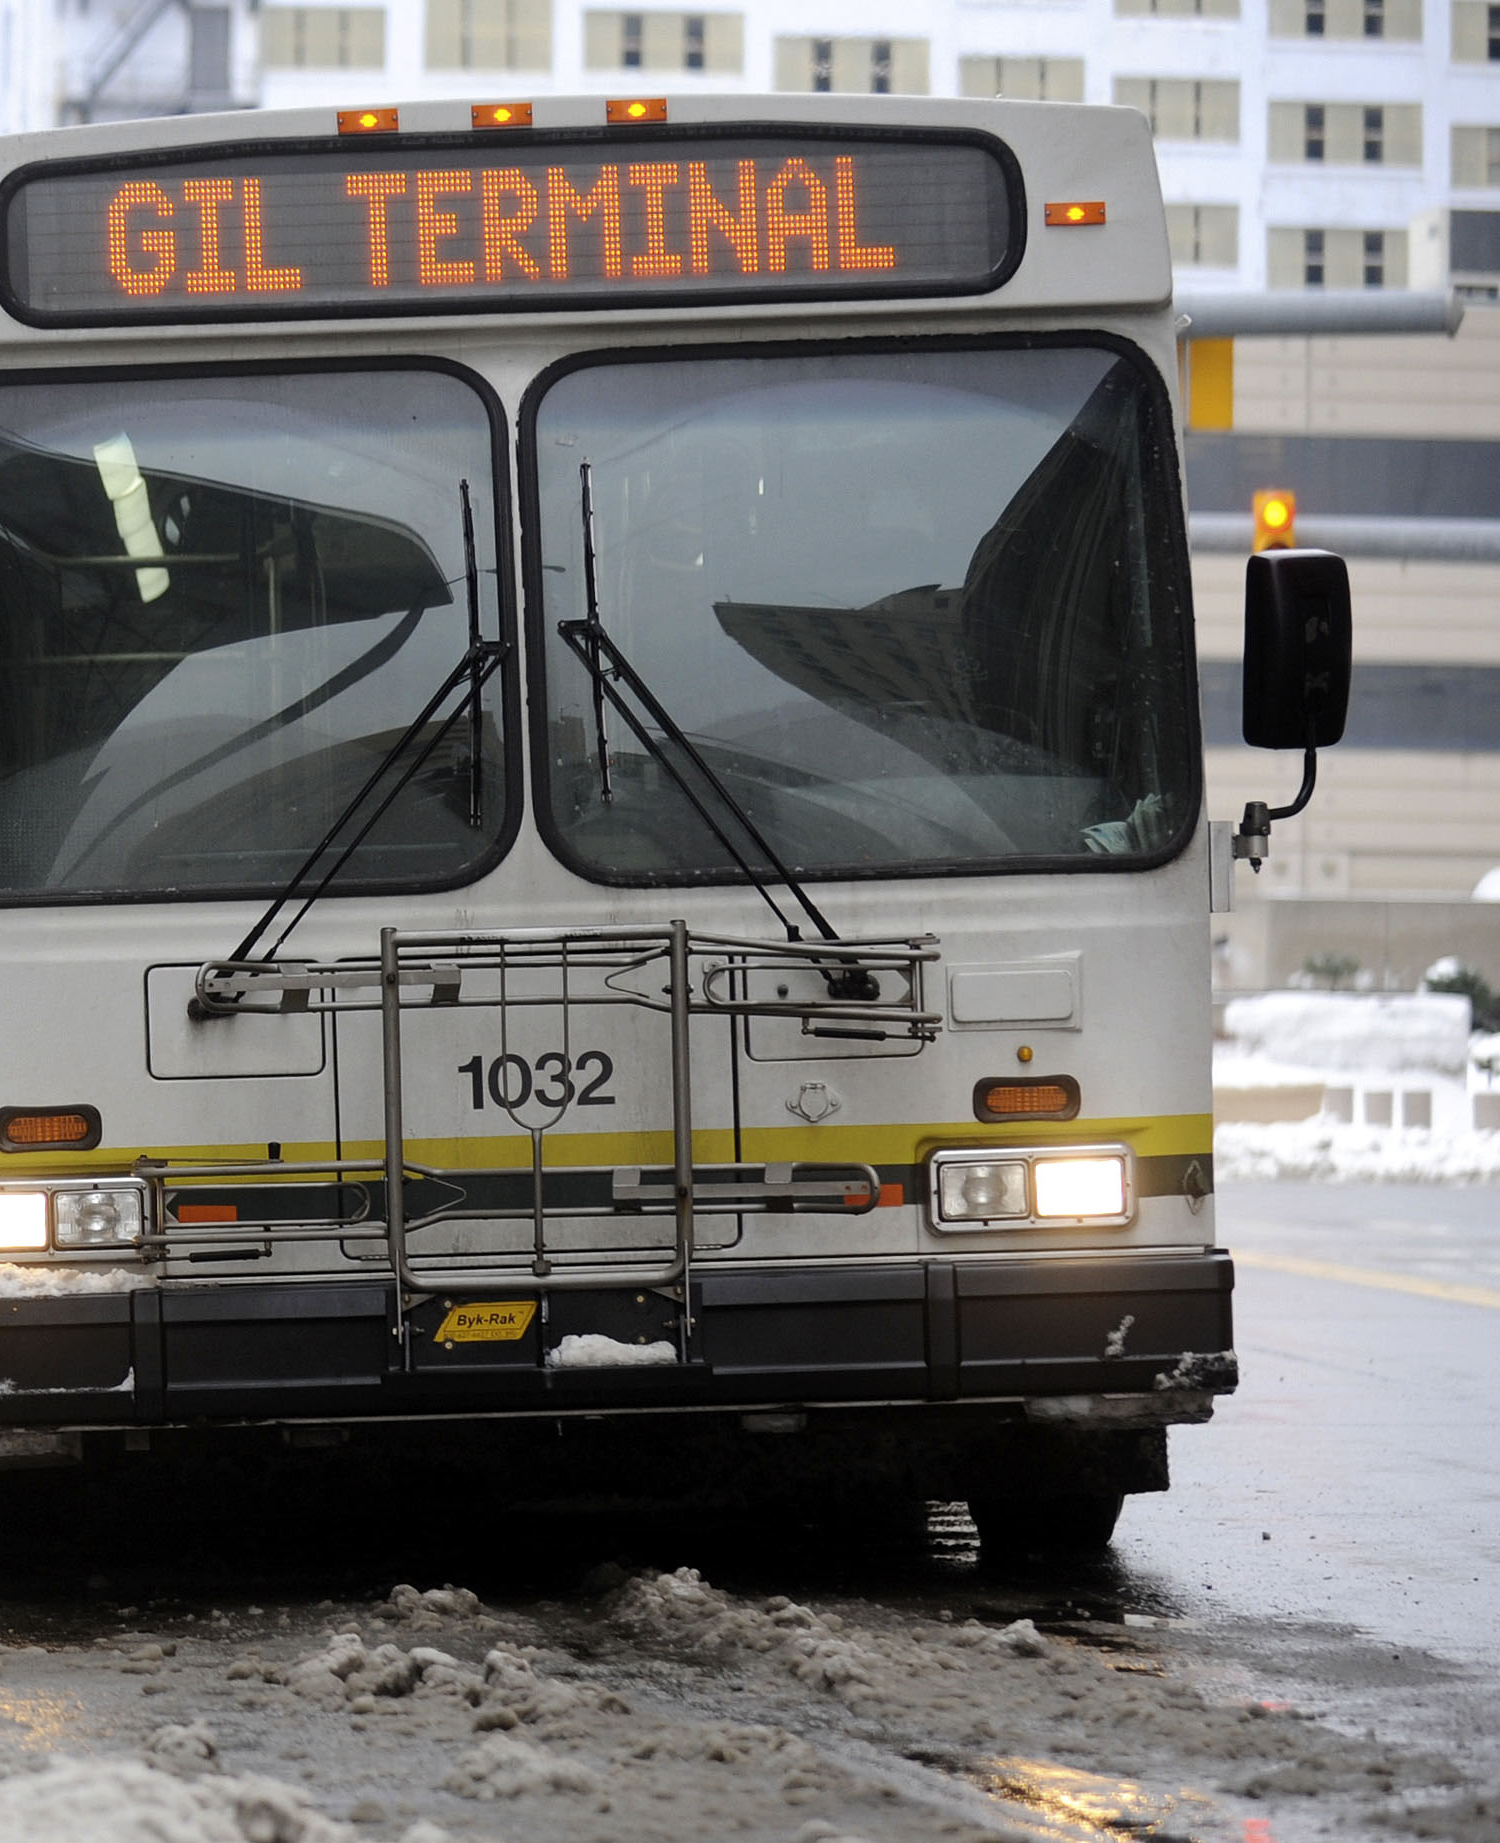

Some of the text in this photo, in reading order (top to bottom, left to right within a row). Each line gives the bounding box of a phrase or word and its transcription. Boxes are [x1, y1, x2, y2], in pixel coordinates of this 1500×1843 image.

[107, 155, 896, 295] GIL TERMINAL
[458, 1050, 616, 1110] 1032
[456, 1312, 517, 1329] Byk-Rak
